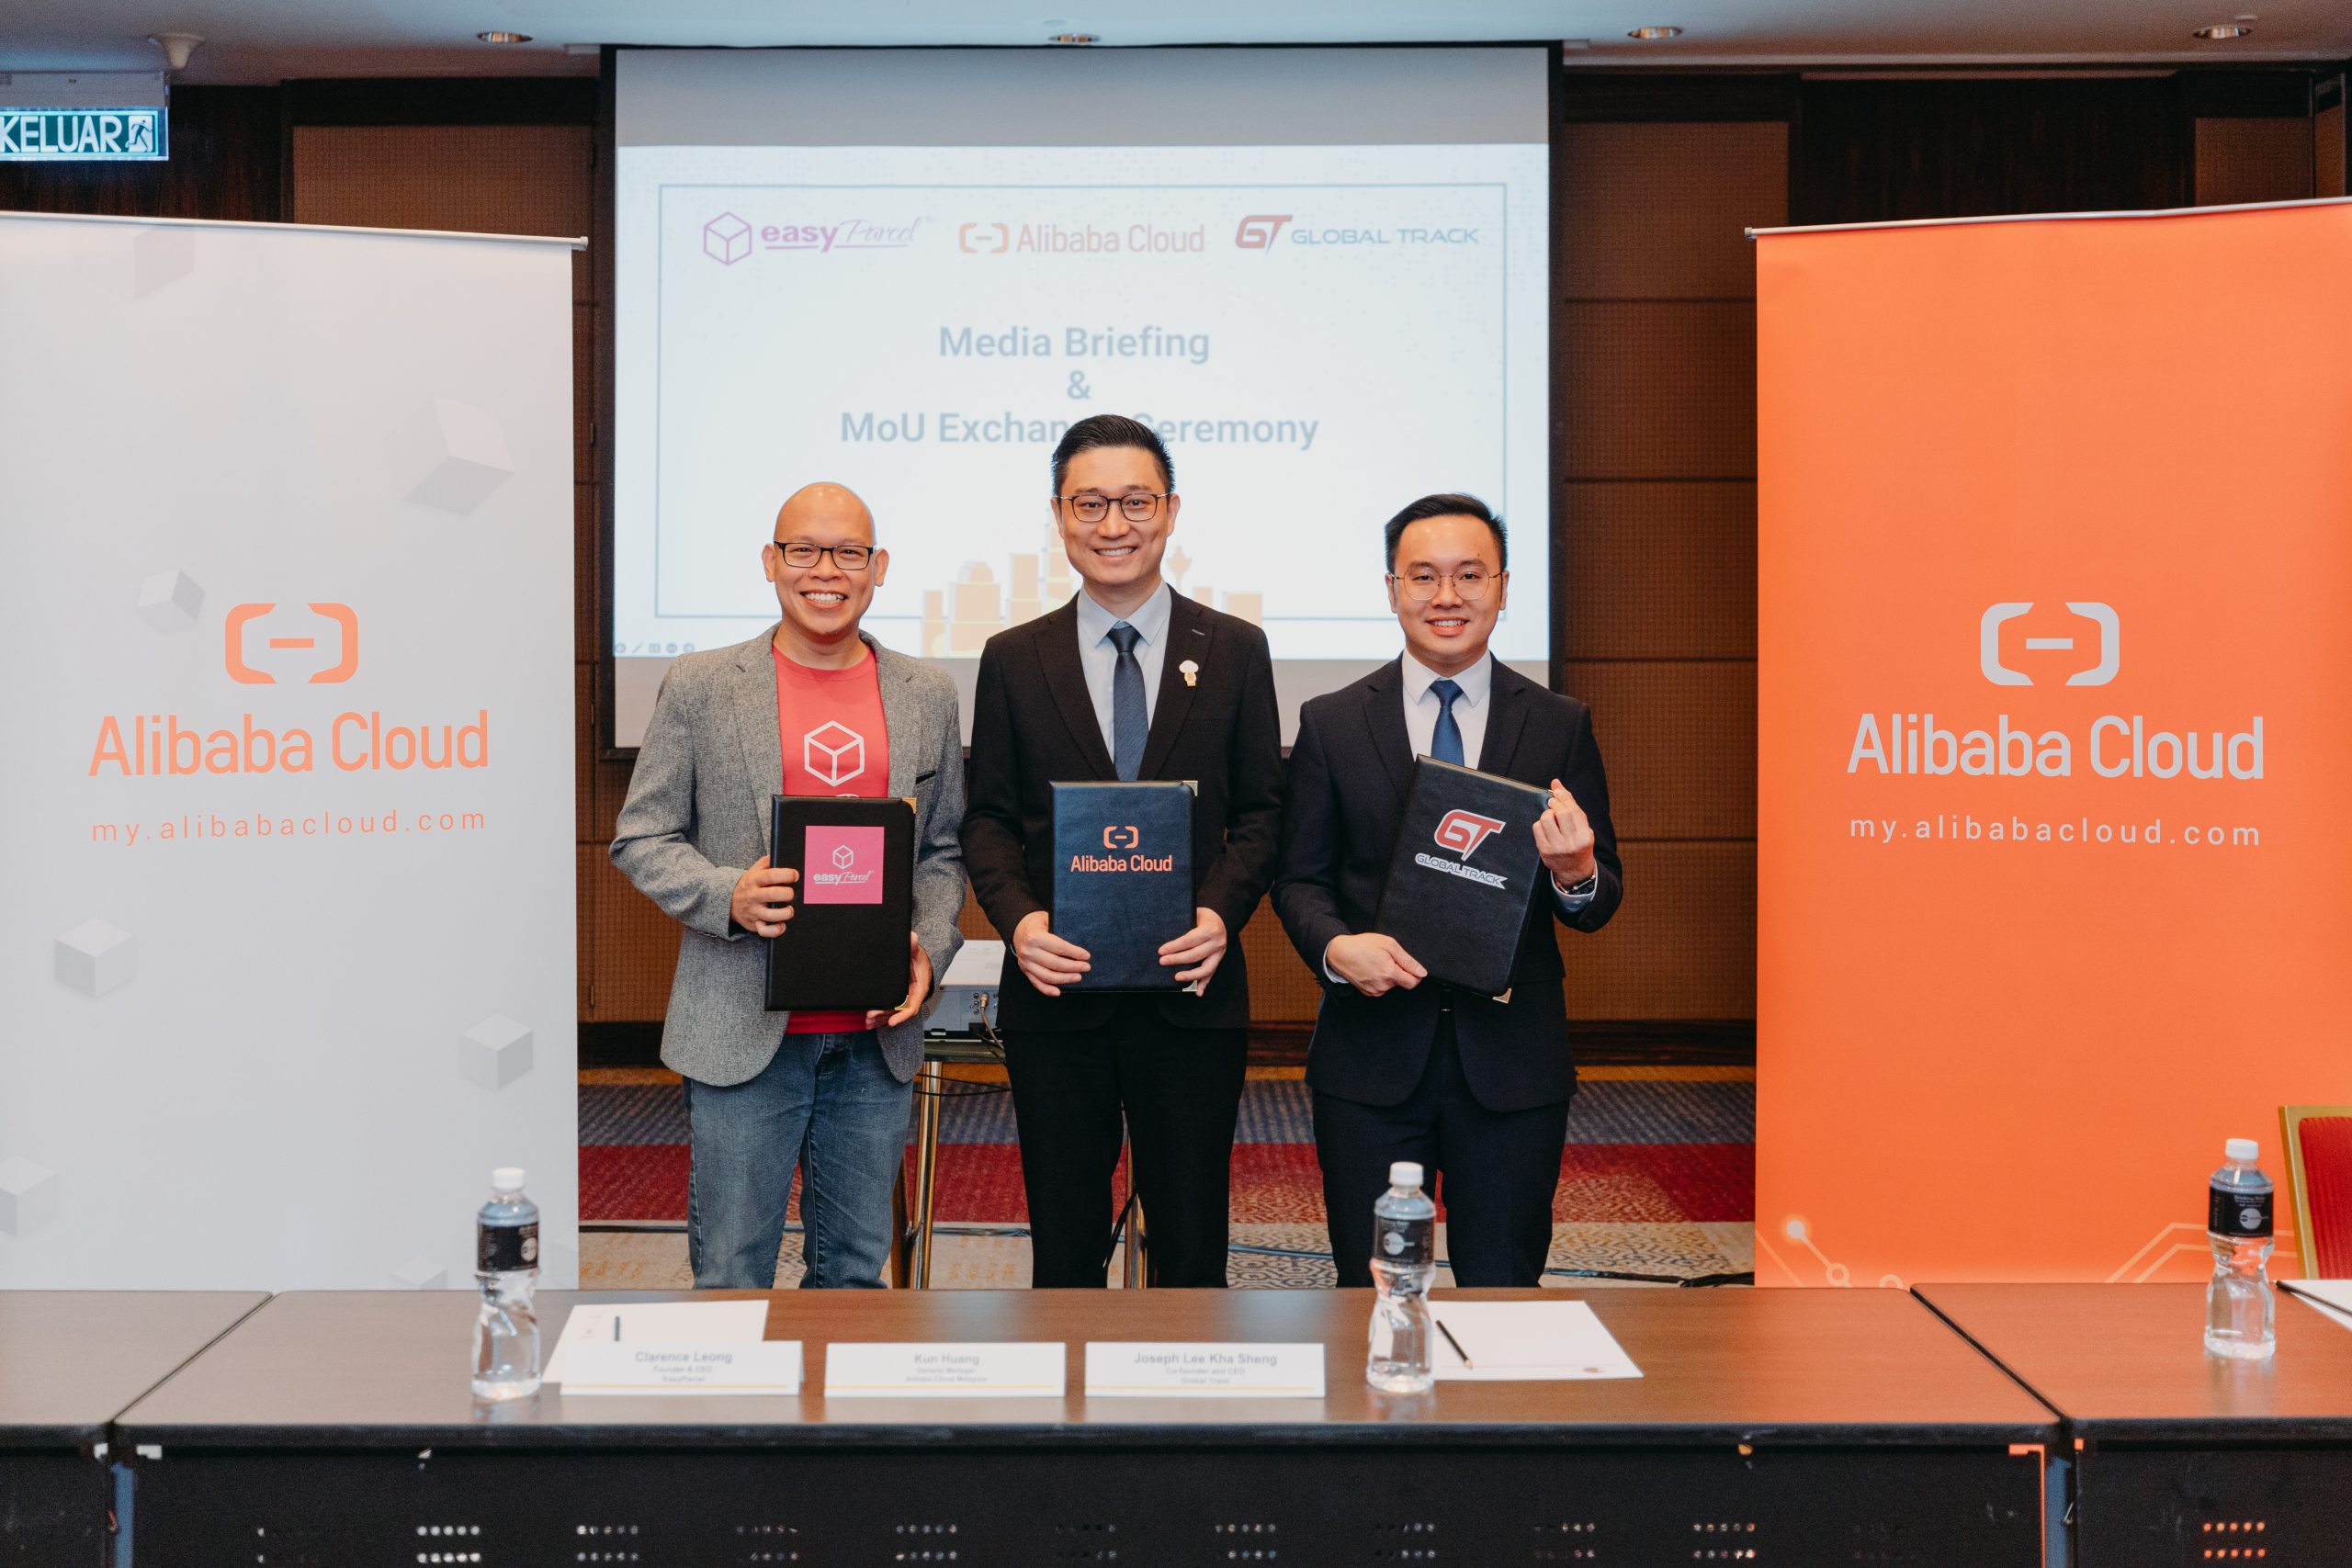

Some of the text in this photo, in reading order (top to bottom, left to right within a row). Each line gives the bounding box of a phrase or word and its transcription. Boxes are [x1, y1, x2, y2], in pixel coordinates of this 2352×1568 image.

[0, 116, 122, 152] KELUAR
[1016, 224, 1204, 253] Alibaba Cloud
[1291, 229, 1479, 244] GLOBAL TRACK
[939, 325, 1210, 365] Media Briefing
[1066, 371, 1091, 400] &
[841, 412, 925, 442] MoU
[939, 412, 1068, 443] Exchan
[88, 709, 488, 777] Alibaba Cloud
[1847, 714, 2264, 780] Alibaba Cloud
[92, 809, 485, 846] my.alibabacloud.com
[1849, 815, 2260, 846] my.alibabacloud.com
[1070, 855, 1172, 872] Alibaba Cloud
[1416, 854, 1503, 886] GLOBAL TRACK
[635, 1351, 733, 1364] Clarence Leong
[914, 1353, 980, 1366] Kun Huang
[1134, 1353, 1277, 1366] Joseph Lee Kha Sheng
